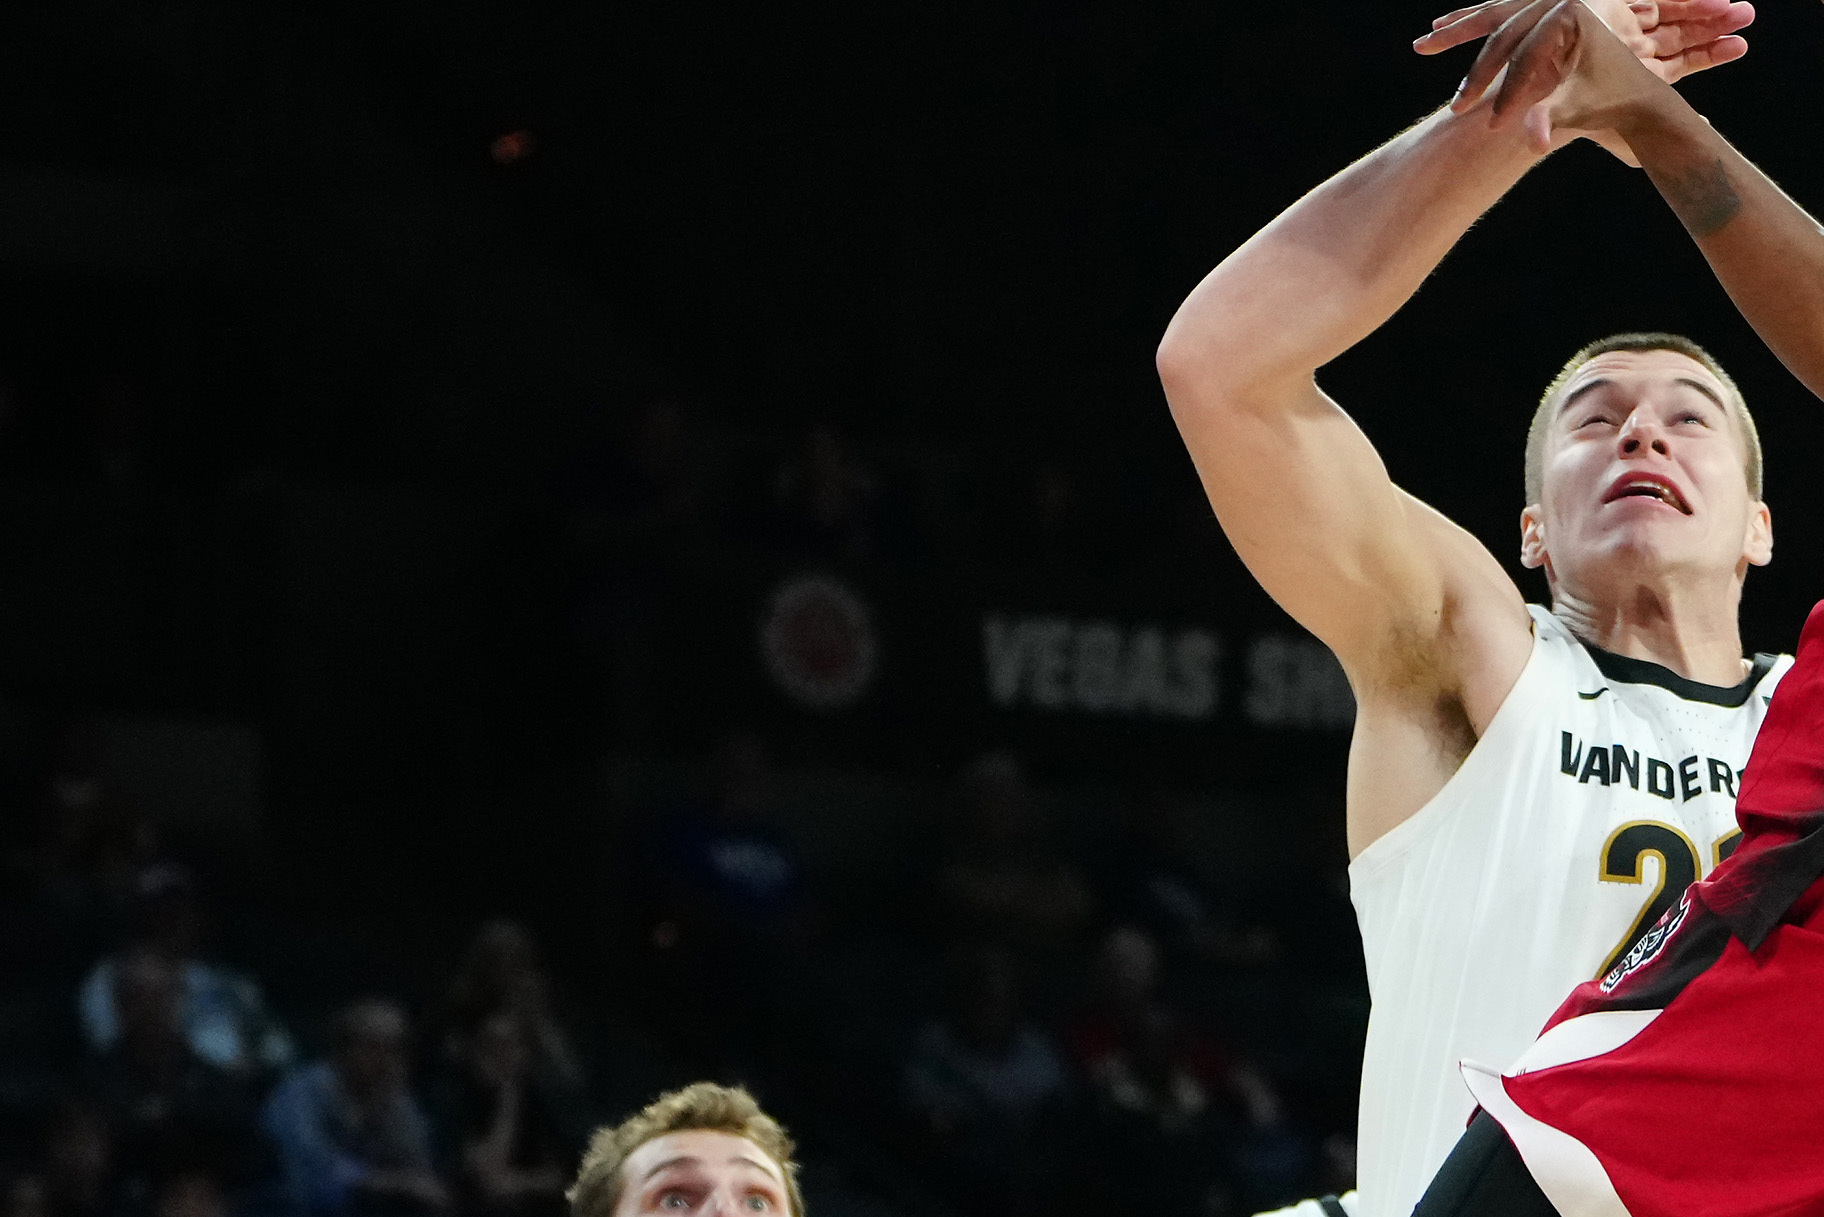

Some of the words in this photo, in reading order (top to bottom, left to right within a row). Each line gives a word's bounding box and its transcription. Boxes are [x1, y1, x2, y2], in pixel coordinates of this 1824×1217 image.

[981, 611, 1221, 721] VEGAS
[1245, 633, 1357, 730] SH
[1560, 730, 1745, 803] VANDER
[1599, 819, 1745, 981] 2
